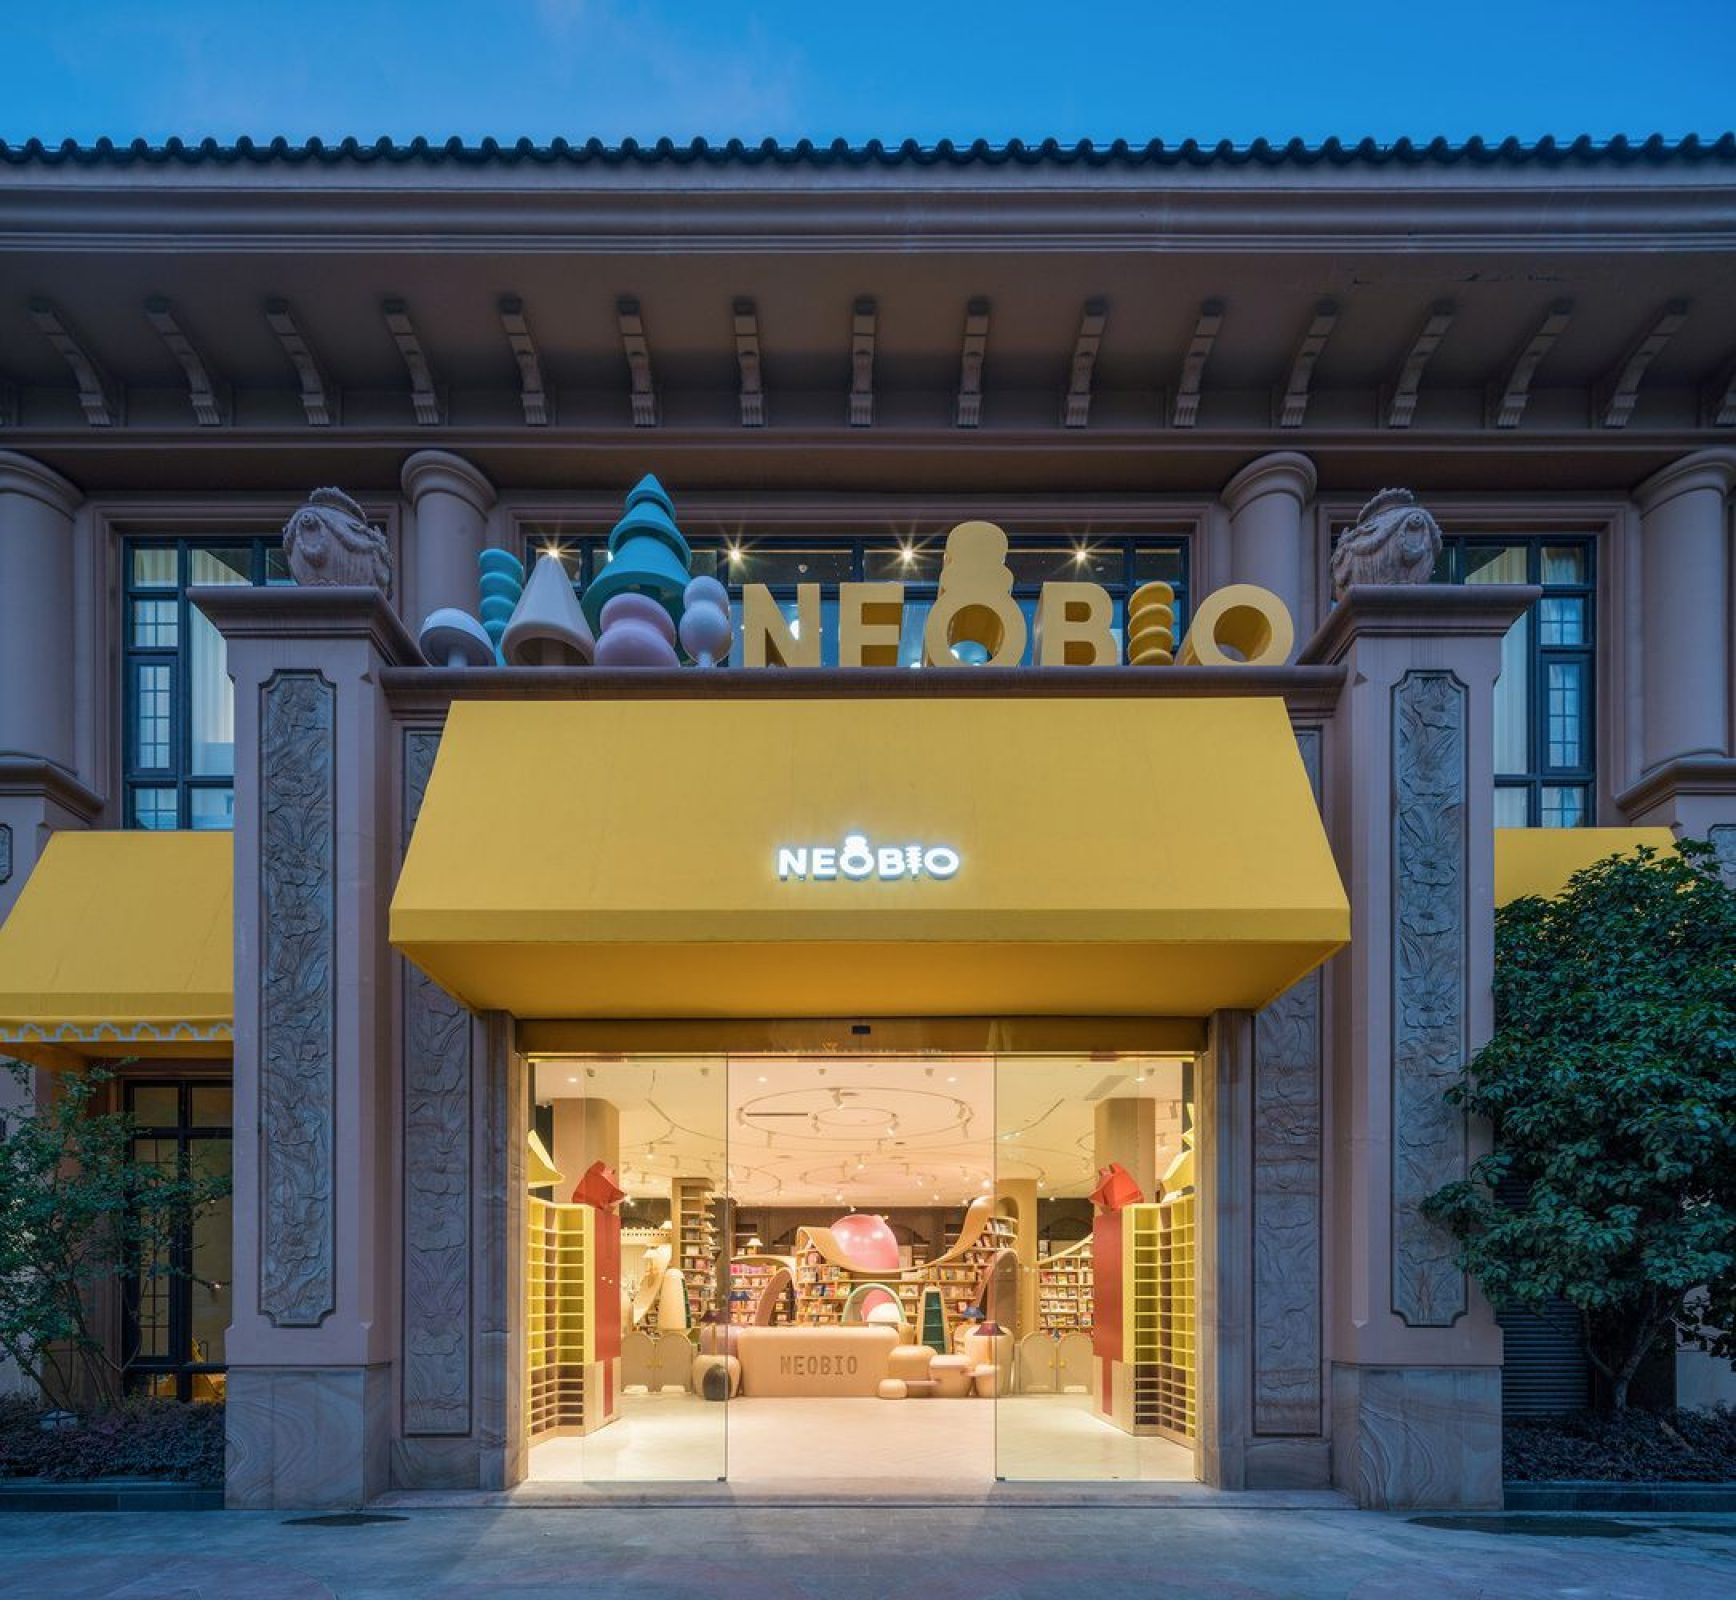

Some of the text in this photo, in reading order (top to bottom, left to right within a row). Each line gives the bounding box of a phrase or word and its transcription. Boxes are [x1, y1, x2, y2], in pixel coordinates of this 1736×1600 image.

[742, 521, 1294, 668] NEOBIO
[778, 835, 960, 880] NEOBIO
[780, 1355, 858, 1376] NEOBIO
